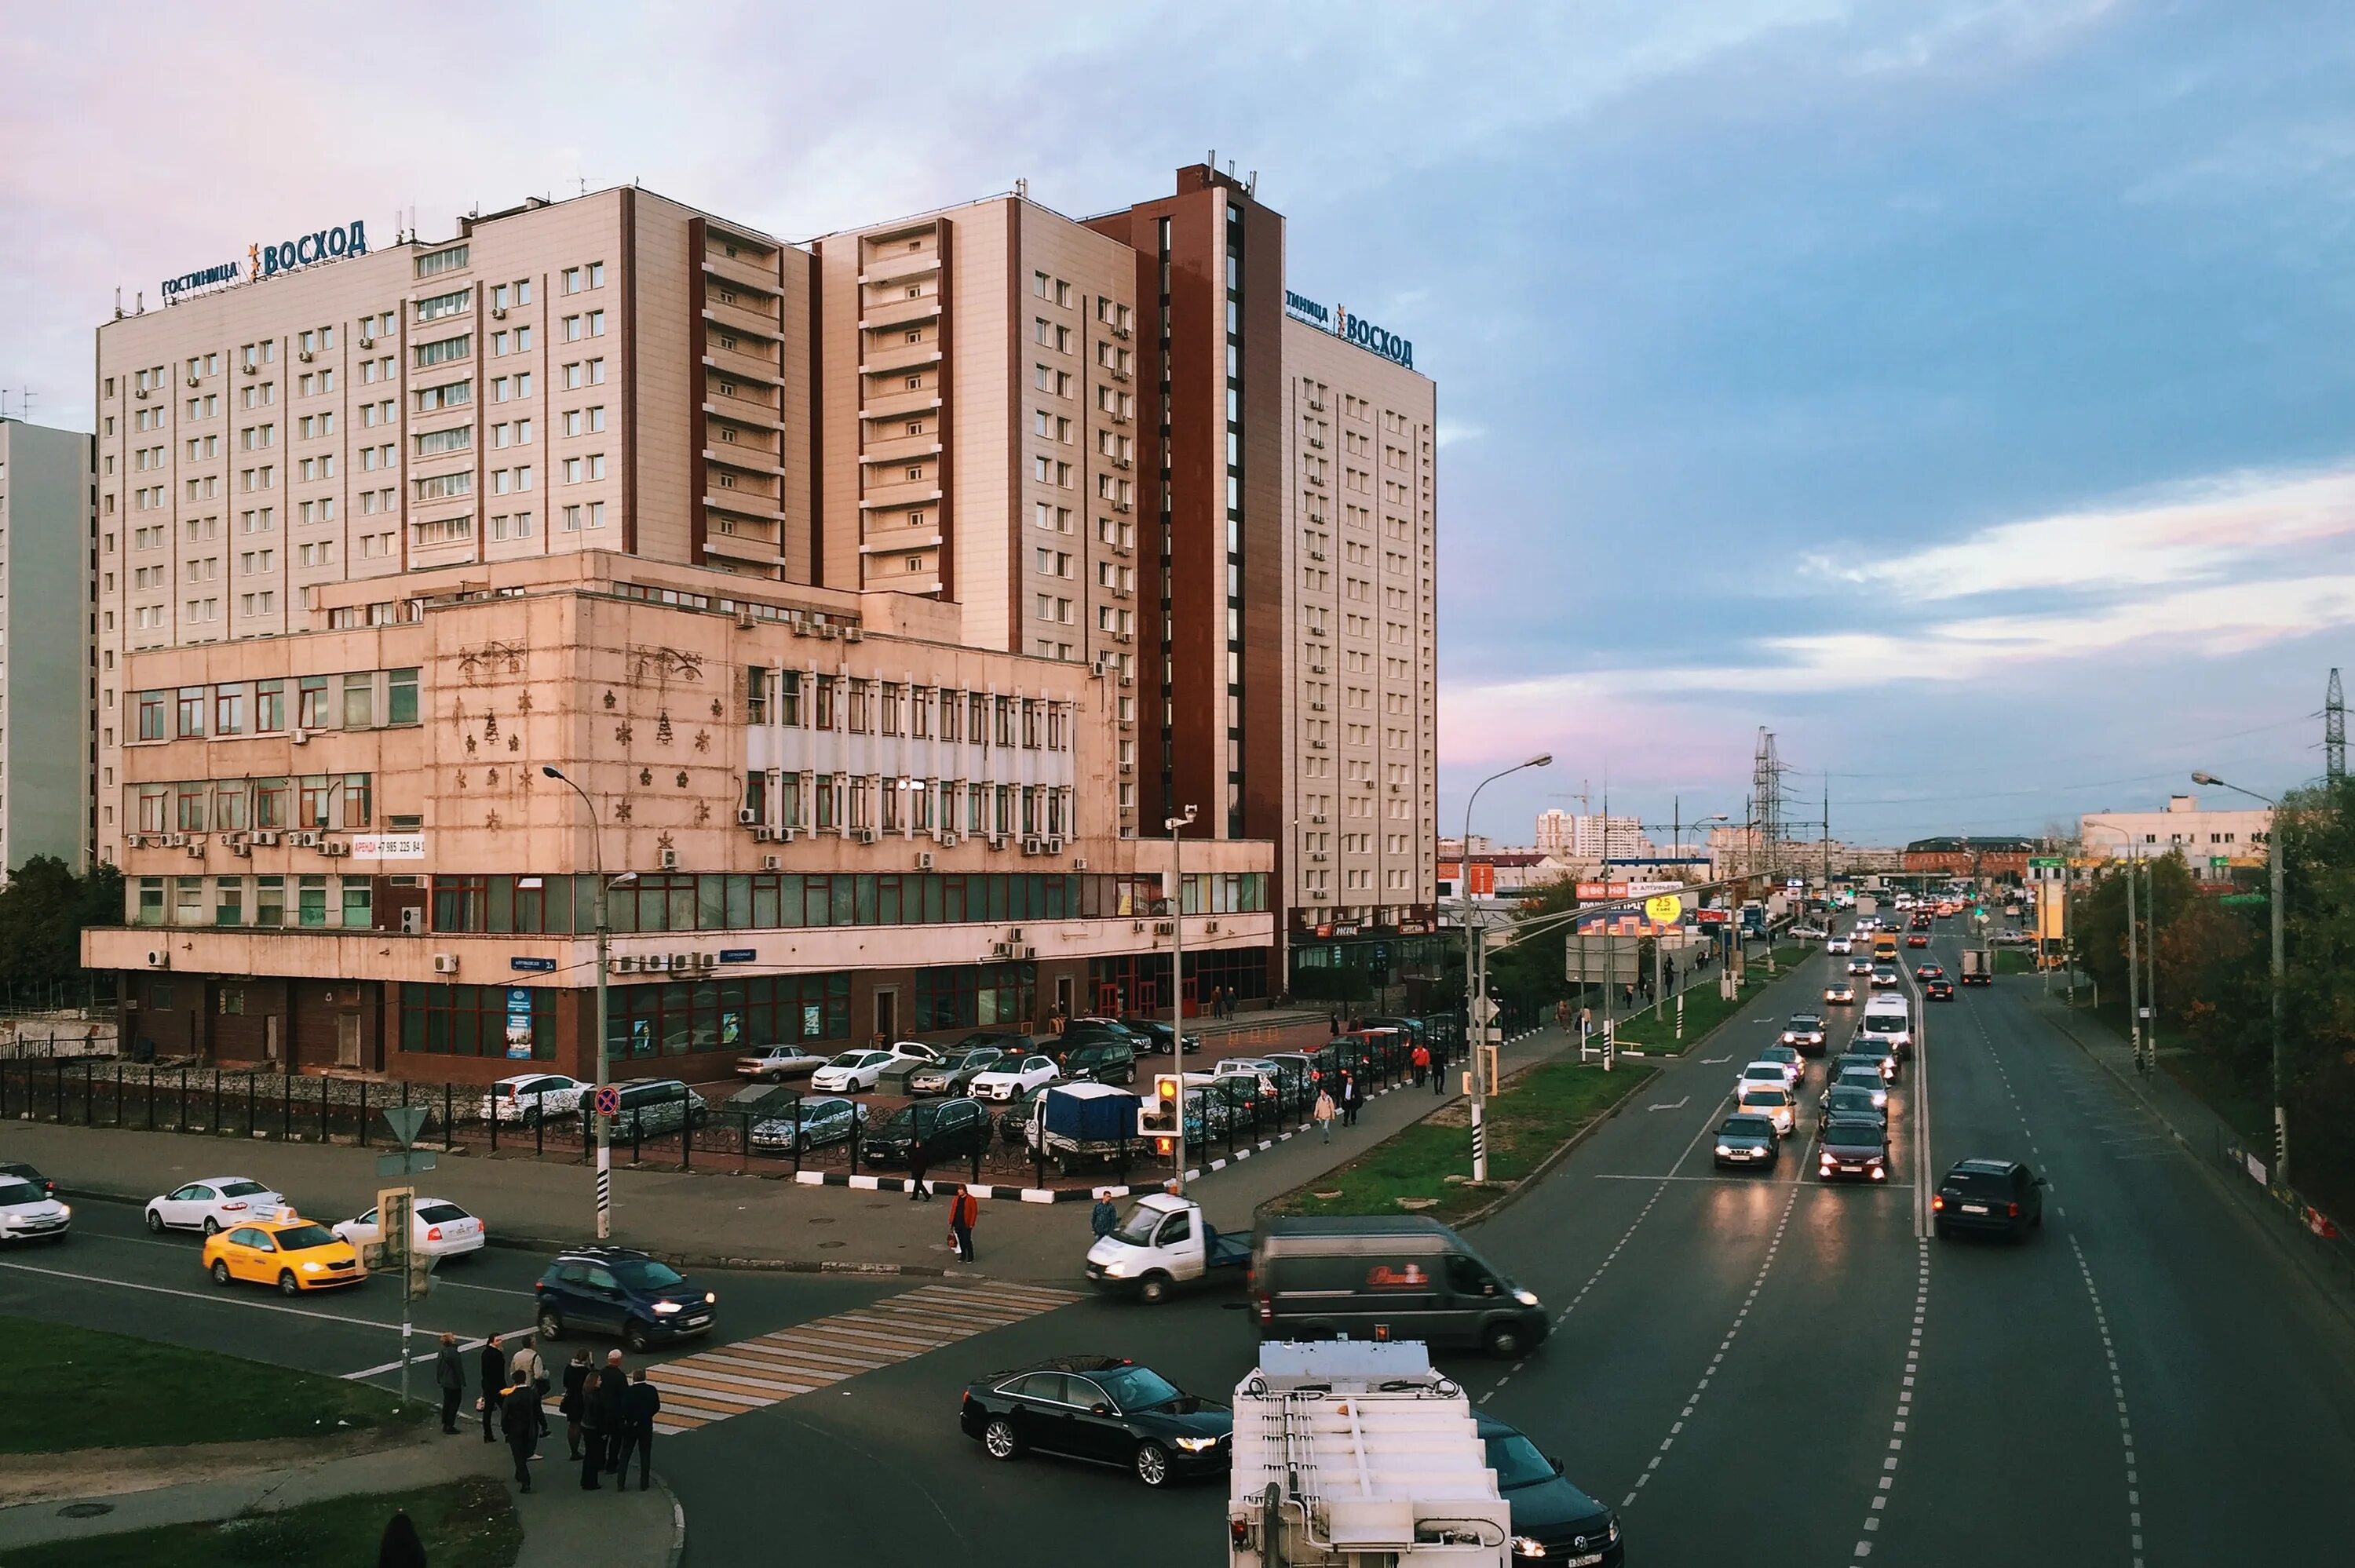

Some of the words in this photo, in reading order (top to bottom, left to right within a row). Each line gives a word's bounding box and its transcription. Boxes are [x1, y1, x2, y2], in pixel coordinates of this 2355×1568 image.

[162, 261, 239, 297] ГОСТИНИЦА
[264, 220, 367, 275] ВОСХОД
[1285, 289, 1329, 323] ТИНИЦА
[1347, 313, 1414, 370] ВОСХОД
